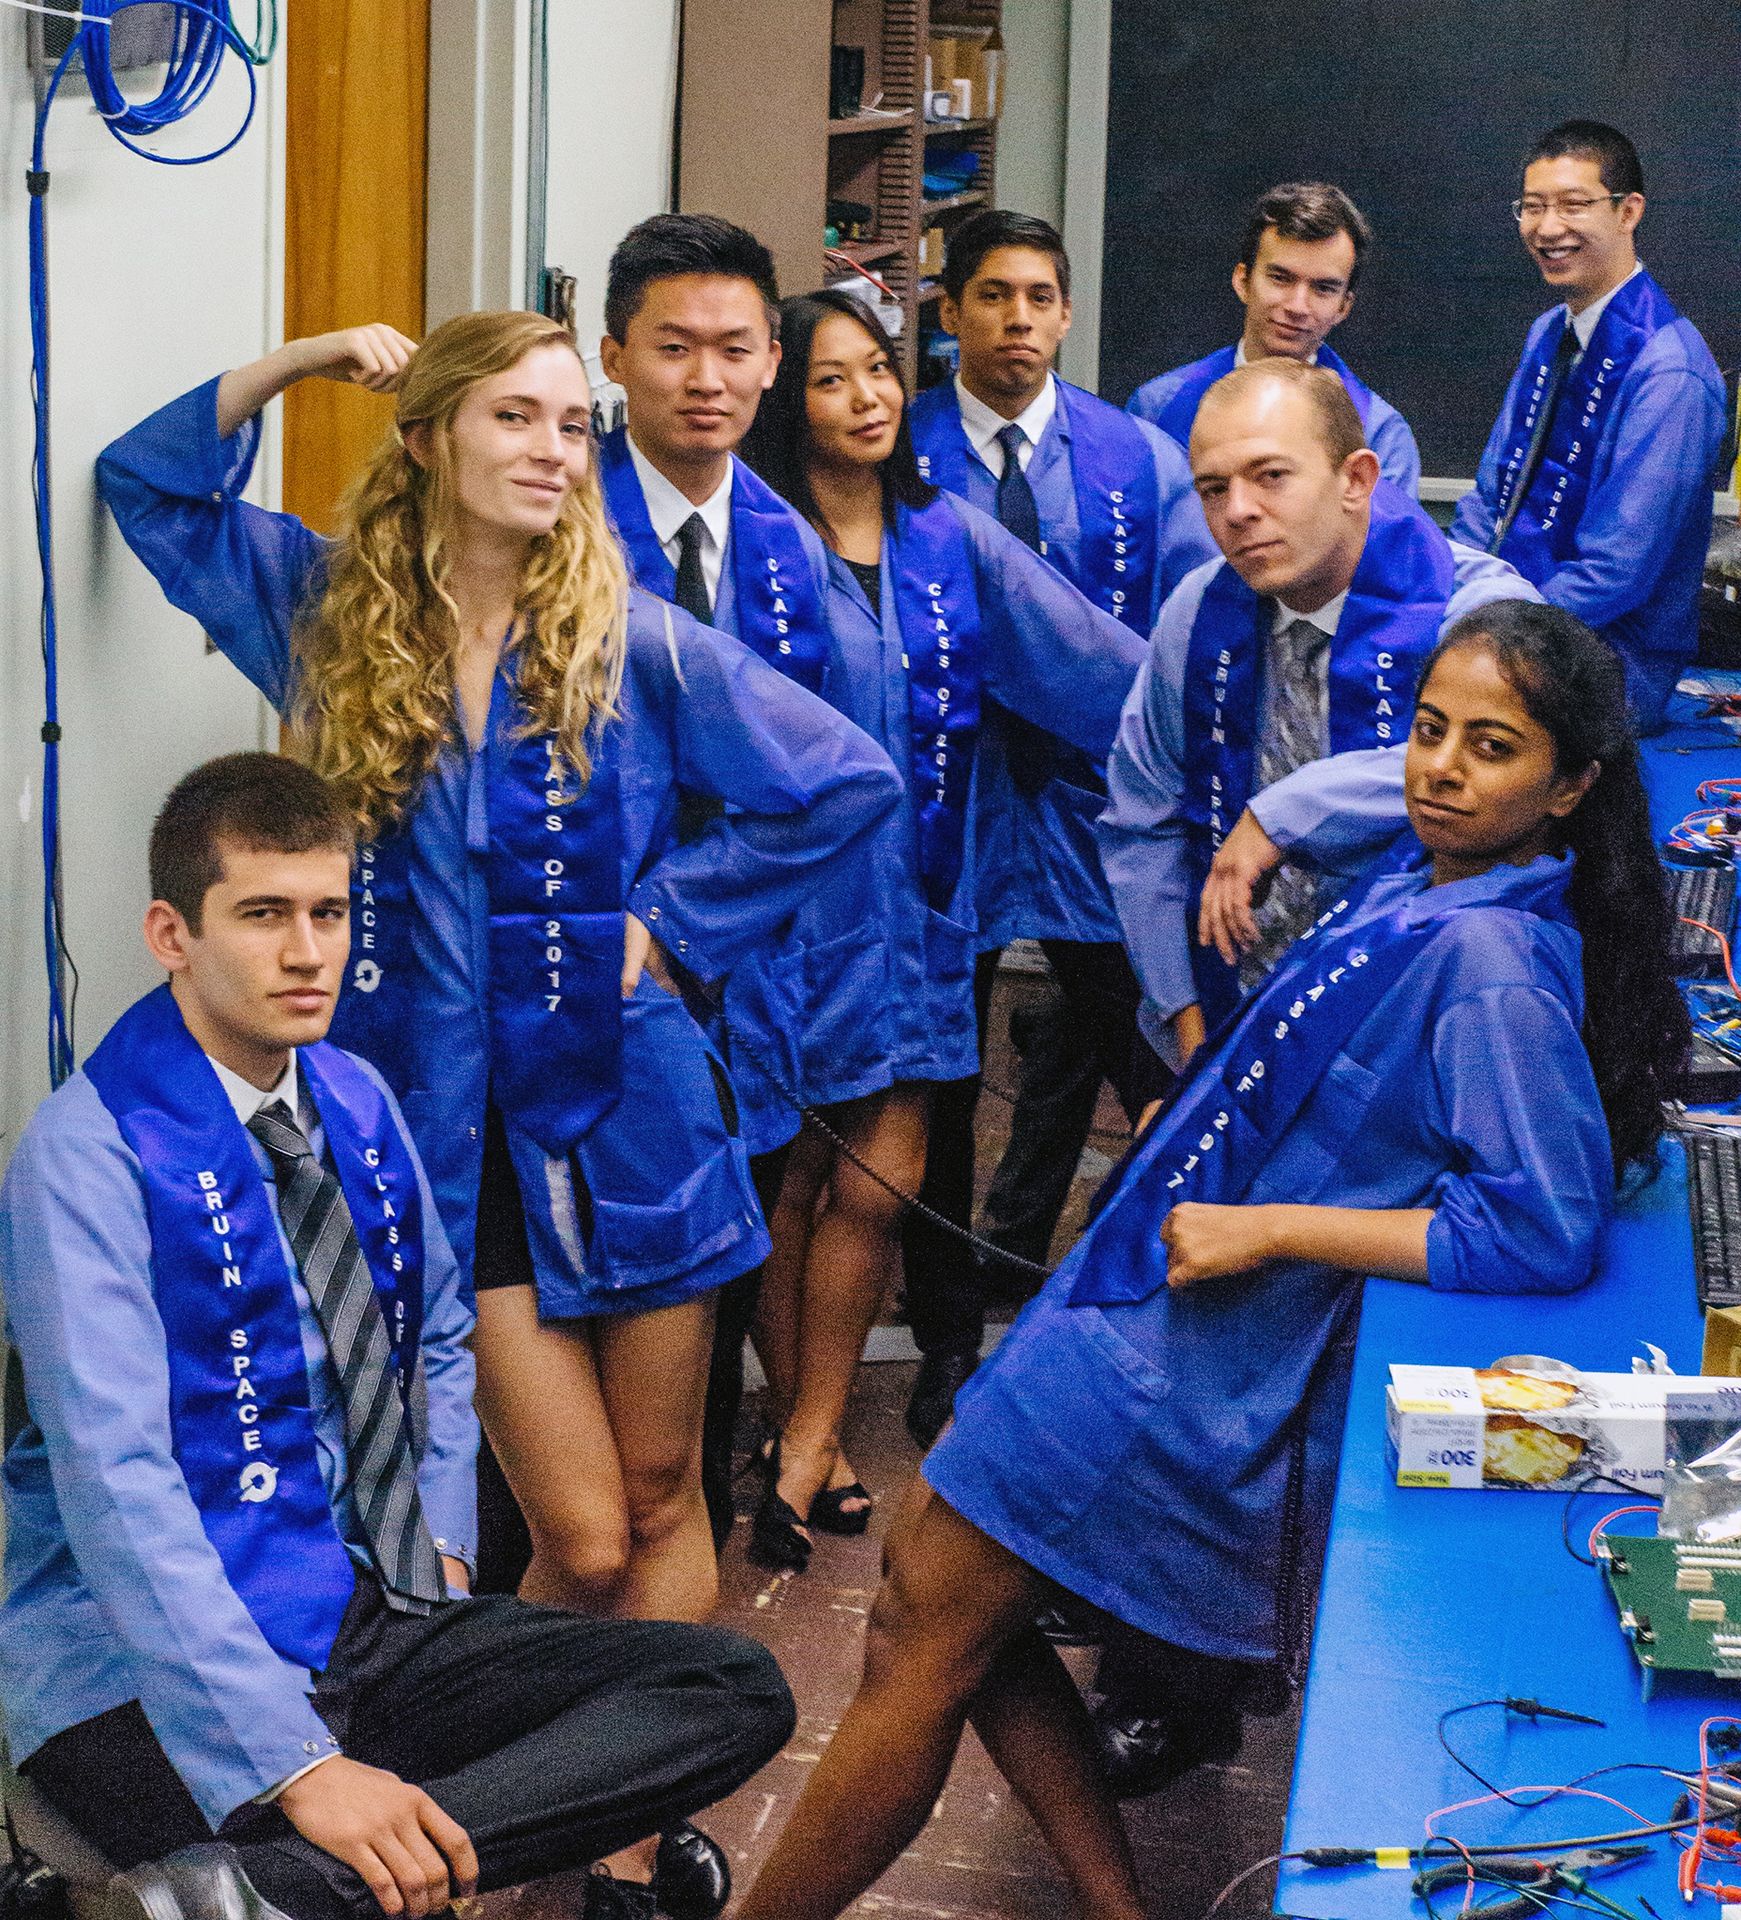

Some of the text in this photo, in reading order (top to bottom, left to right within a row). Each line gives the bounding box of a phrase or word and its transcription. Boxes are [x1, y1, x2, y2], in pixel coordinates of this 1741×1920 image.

[1541, 358, 1614, 530] CLASS OF 2017
[1110, 491, 1126, 617] CLASS OF
[767, 558, 791, 654] CLASS
[928, 583, 949, 802] CLASS OF 2017
[1376, 652, 1393, 751] CLAS
[1210, 775, 1222, 857] SPAC
[361, 846, 376, 949] SPACE
[544, 859, 564, 898] OF
[545, 920, 562, 1012] 2017
[1166, 953, 1369, 1189] CLASS OF 2017
[364, 1148, 403, 1272] CLASS
[197, 1171, 262, 1451] BRUIN SPACE
[1441, 1450, 1476, 1467] 300
[1611, 1468, 1638, 1481] Foil
